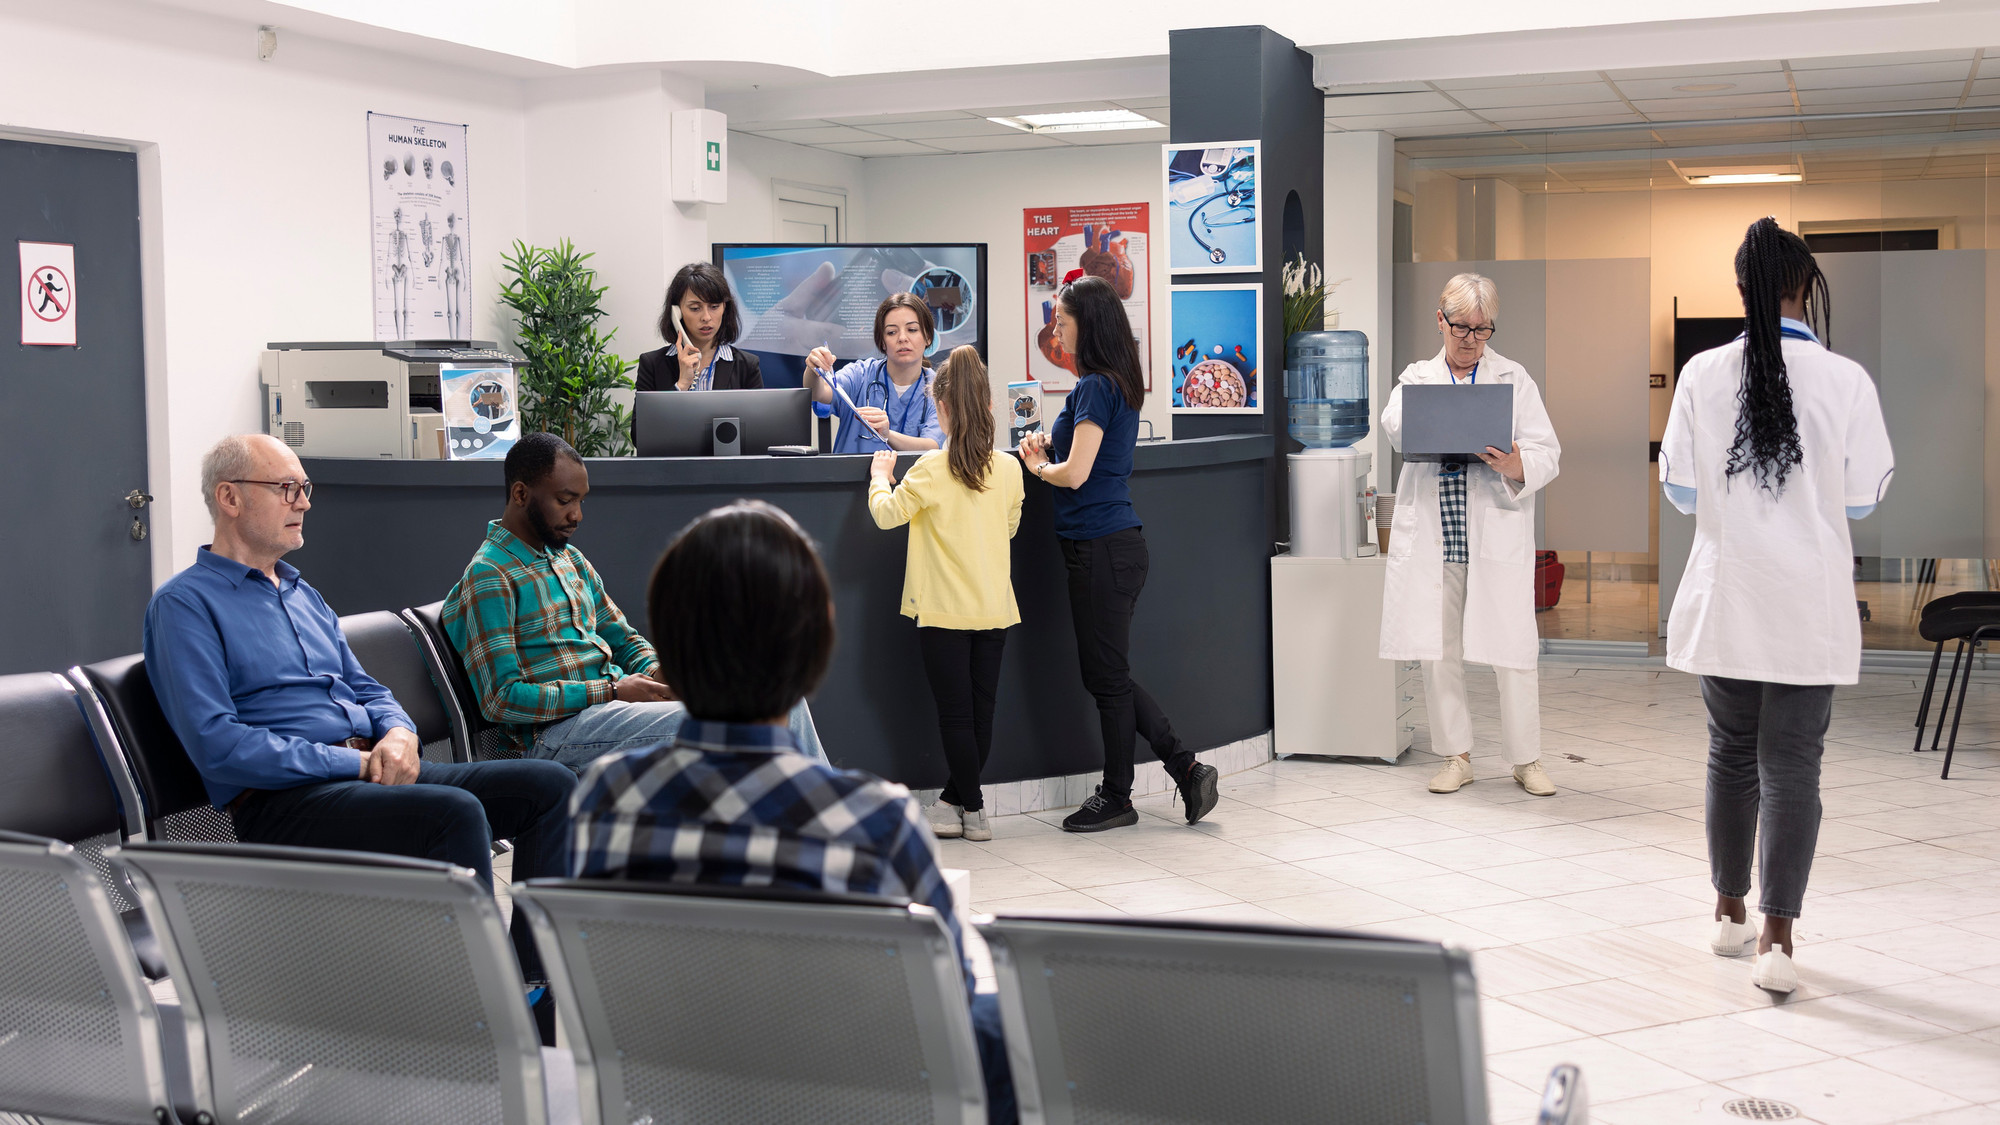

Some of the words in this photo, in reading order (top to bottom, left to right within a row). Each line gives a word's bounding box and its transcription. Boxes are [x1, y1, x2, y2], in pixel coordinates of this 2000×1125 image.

[413, 126, 425, 135] THE
[388, 134, 413, 145] HUMAN
[413, 137, 447, 149] SKELETON
[1033, 215, 1053, 224] THE
[1027, 226, 1060, 236] HEART
